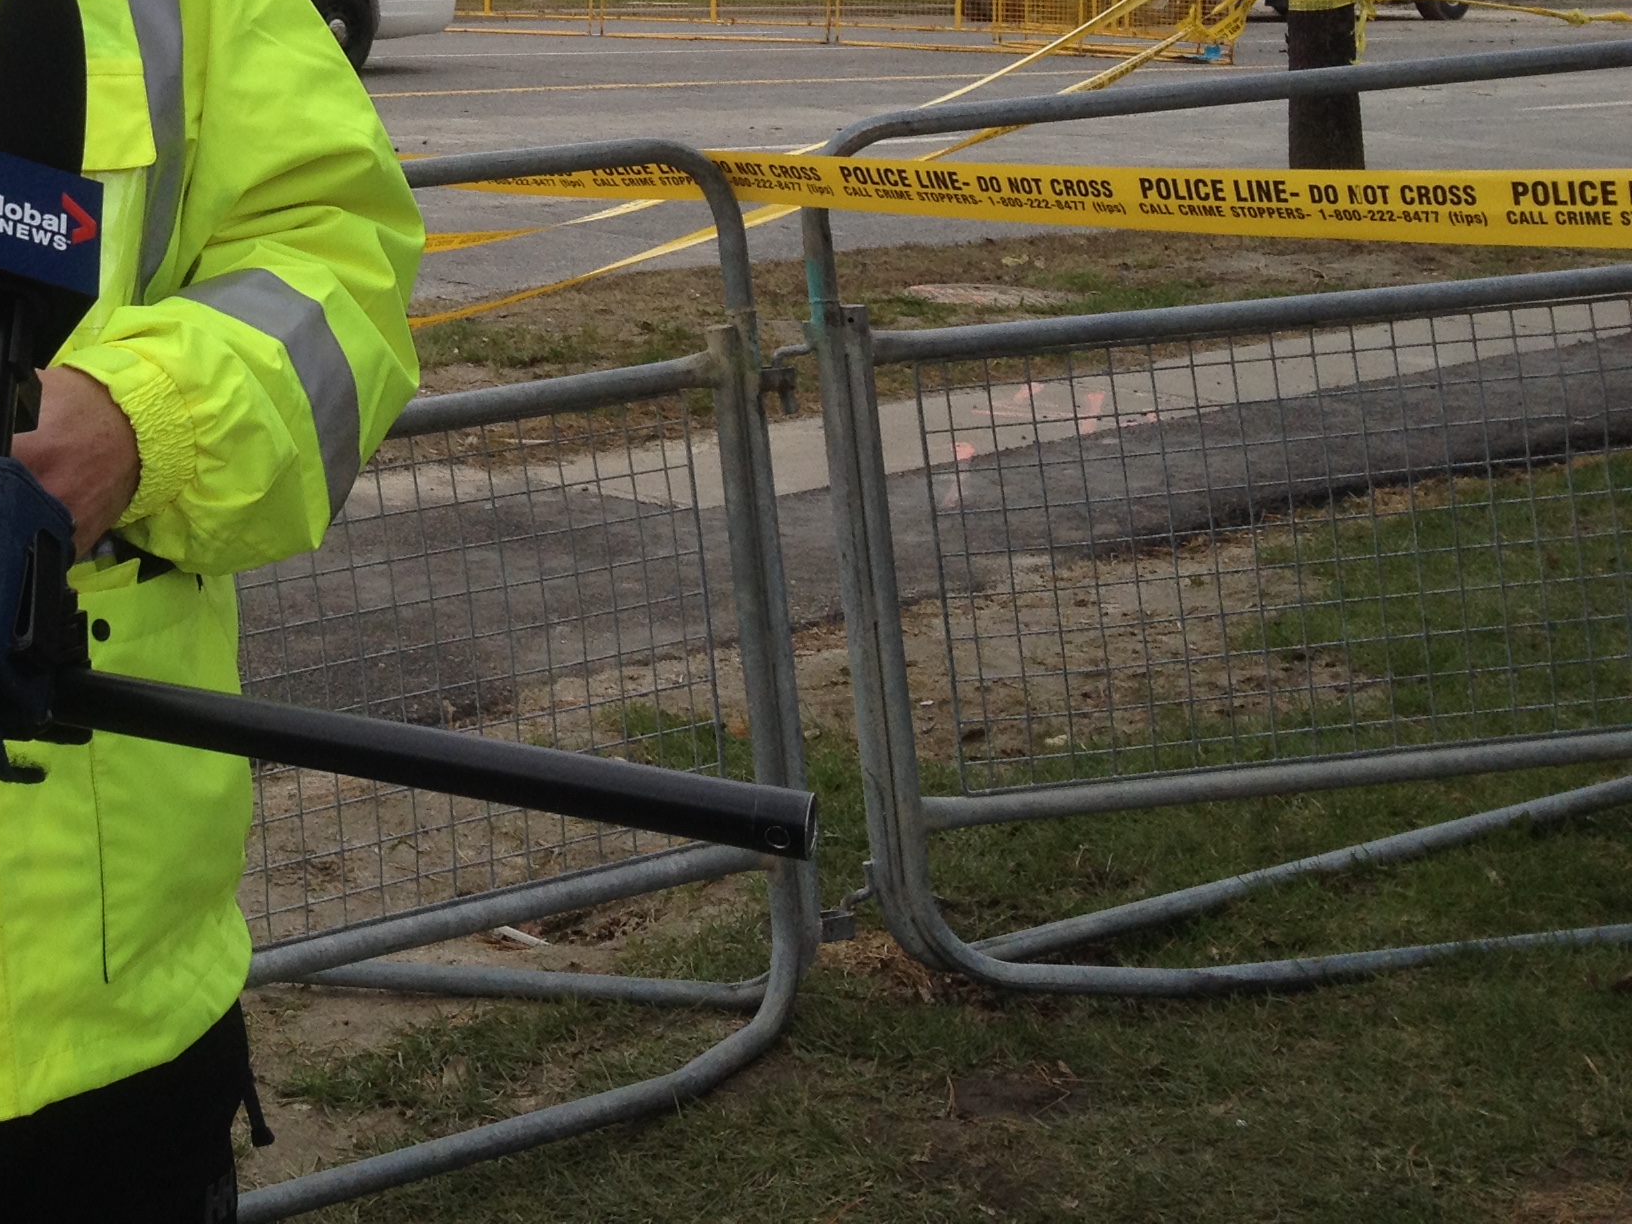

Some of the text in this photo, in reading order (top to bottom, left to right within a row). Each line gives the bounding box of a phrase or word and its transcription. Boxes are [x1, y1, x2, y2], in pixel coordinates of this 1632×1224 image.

[592, 177, 620, 187] CALL
[622, 176, 657, 187] CRIME
[734, 161, 766, 177] NOT
[768, 163, 822, 182] CROSS
[838, 165, 910, 189] POLICE
[976, 175, 1002, 193] DO
[1007, 176, 1043, 196] NOT
[1049, 178, 1114, 199] CROSS
[806, 182, 835, 197] (tips)
[842, 185, 873, 198] CALL
[876, 187, 913, 201] CRIME
[987, 195, 1087, 212] 1-800-222-8477
[1091, 201, 1128, 216] (tips)
[1138, 177, 1227, 202] POLICE
[1307, 183, 1340, 205] DO
[1347, 184, 1390, 206] NOT
[1399, 184, 1478, 207] CROSS
[1510, 180, 1618, 207] POLICE
[1138, 202, 1175, 216] CALL
[1177, 204, 1227, 218] CRIME
[1317, 209, 1440, 224] 1-800-222-8477
[1447, 211, 1489, 227] (tips)
[1505, 210, 1549, 226] CALL
[1555, 210, 1613, 226] CRIME
